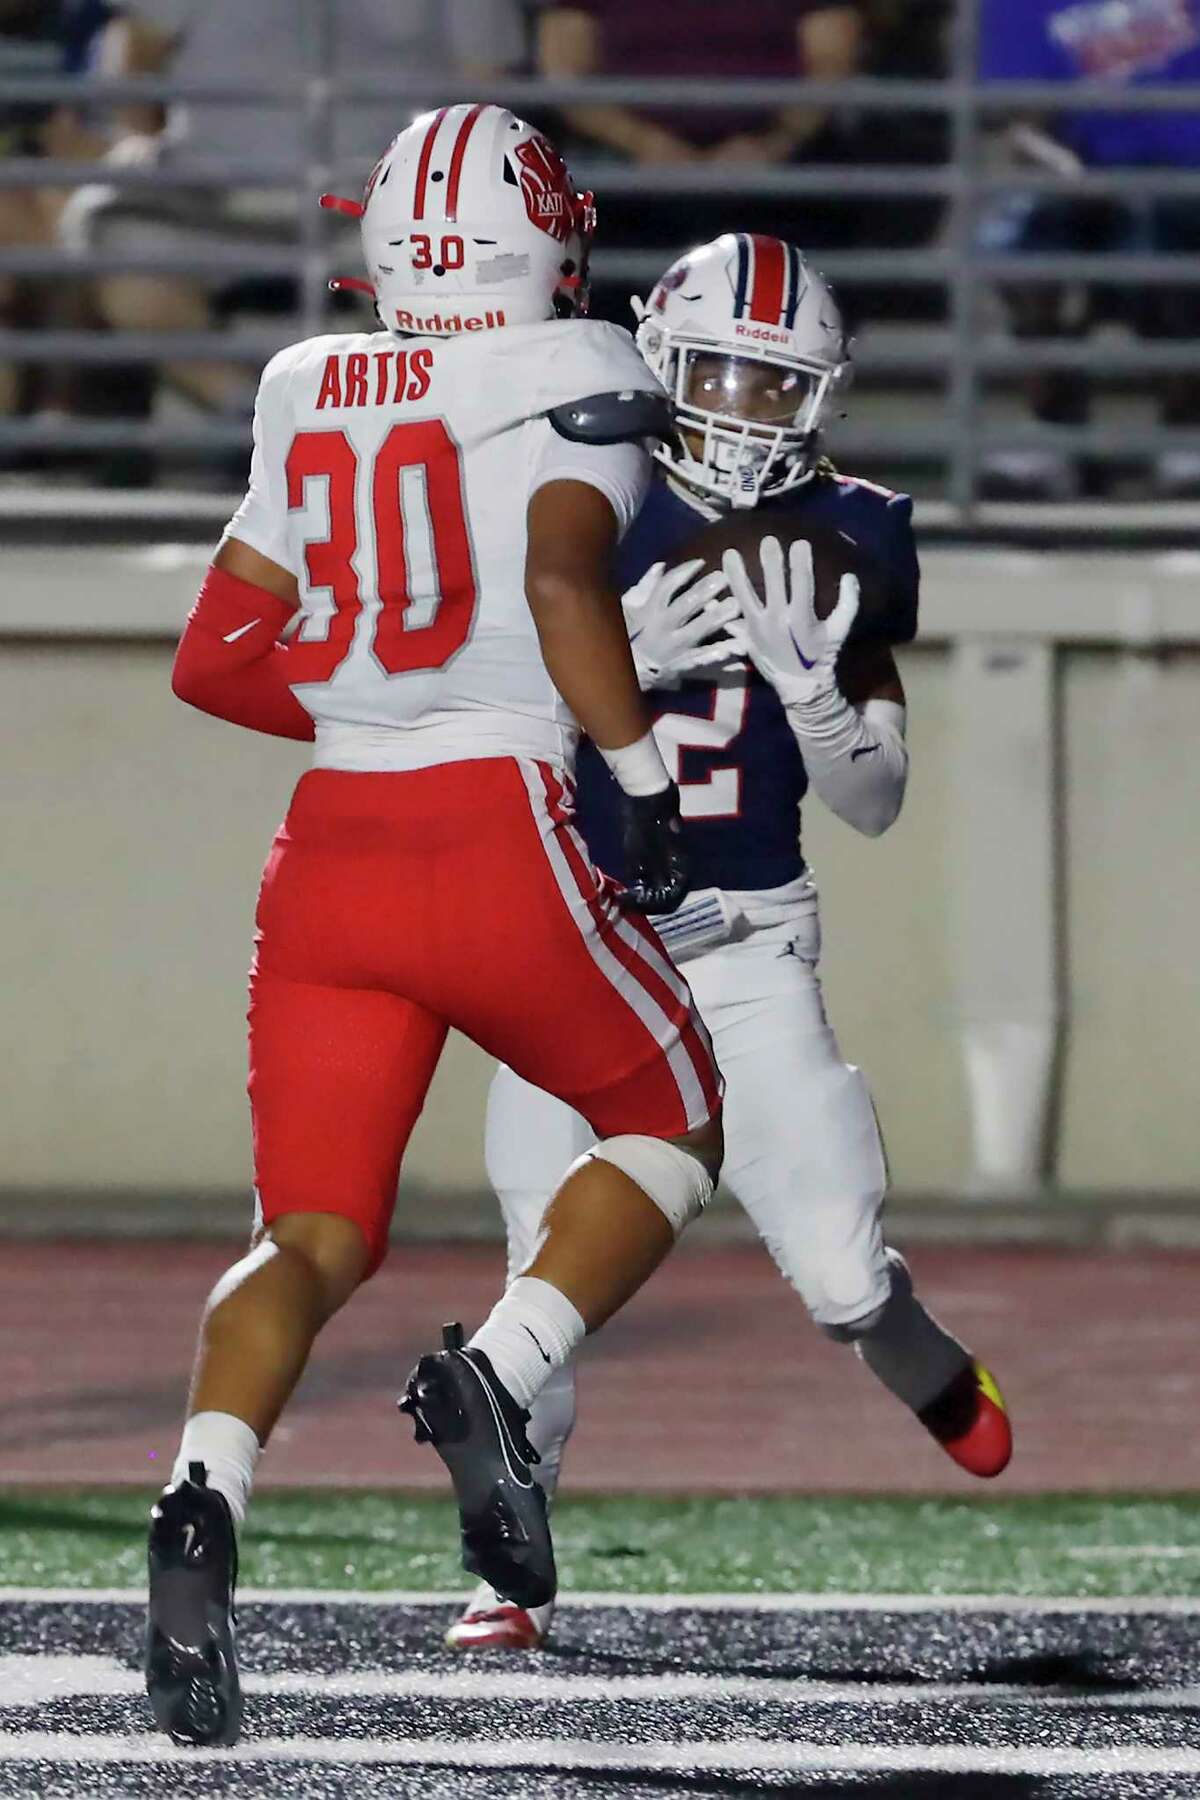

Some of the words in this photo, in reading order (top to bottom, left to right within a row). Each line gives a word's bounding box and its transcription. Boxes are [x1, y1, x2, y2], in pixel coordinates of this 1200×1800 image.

[410, 234, 465, 269] 30
[395, 309, 505, 331] Riddell
[735, 324, 788, 344] Riddell
[315, 349, 433, 409] ARTIS
[285, 416, 481, 686] 30
[650, 658, 749, 821] 2
